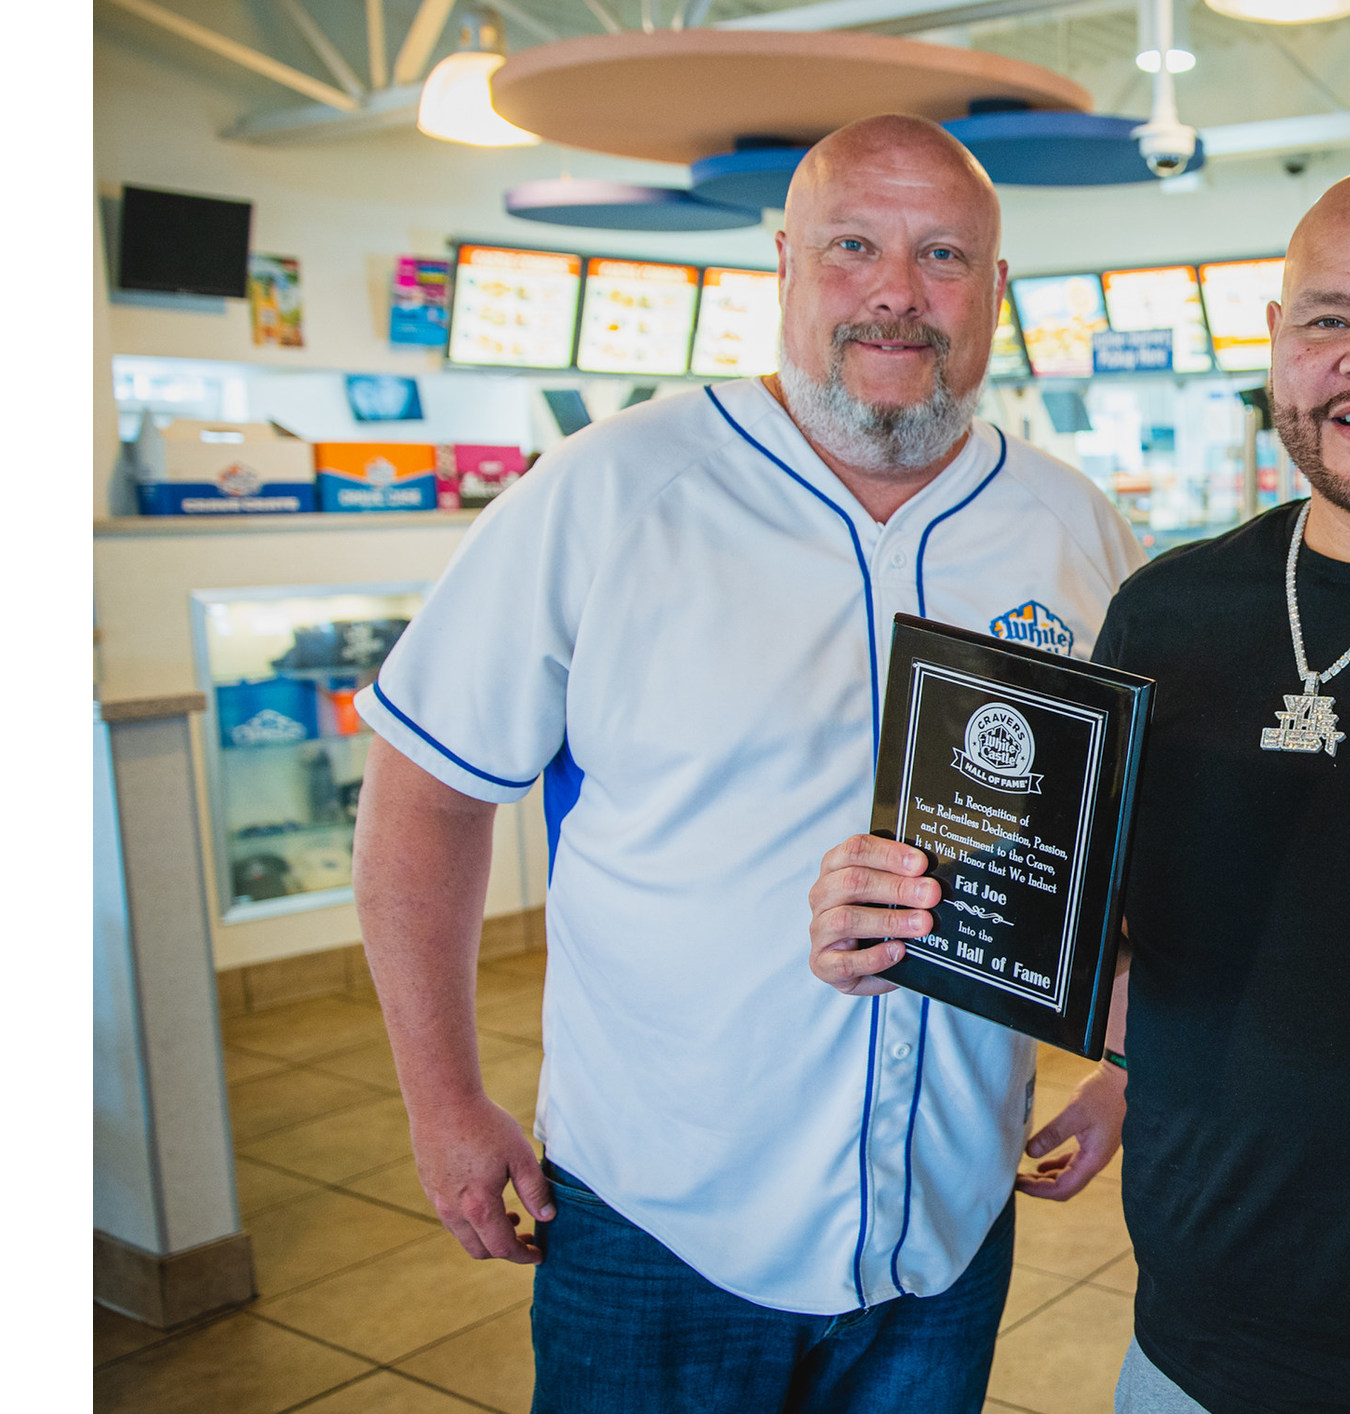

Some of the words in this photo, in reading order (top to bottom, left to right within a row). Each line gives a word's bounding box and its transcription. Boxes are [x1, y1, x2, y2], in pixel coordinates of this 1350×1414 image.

[1004, 619, 1068, 648] White
[978, 713, 1025, 740] CRAVERS
[981, 746, 1016, 765] Castle
[985, 733, 1016, 754] White
[965, 763, 987, 781] HALL
[988, 775, 1001, 785] OF
[954, 791, 963, 806] In
[965, 795, 1017, 823] Recognition
[1019, 814, 1030, 828] of
[915, 796, 935, 814] Your
[937, 803, 979, 829] Relentless
[981, 819, 1031, 848] Dedication,
[1033, 835, 1068, 861] Passion,
[920, 821, 937, 834] and
[939, 824, 994, 854] Commitment
[997, 846, 1006, 858] to
[1008, 849, 1024, 864] the
[1025, 853, 1056, 876] Crave,
[914, 834, 922, 848] It
[924, 840, 932, 851] is
[934, 840, 956, 860] With
[958, 849, 986, 870] Honor
[988, 861, 1006, 877] that
[1009, 865, 1026, 884] We
[1028, 873, 1058, 895] Induct
[954, 874, 979, 896] Fat
[981, 884, 1008, 906] Joe
[958, 920, 976, 937] Into
[978, 928, 994, 943] the
[956, 940, 984, 965] Hall
[991, 956, 1007, 973] of
[1012, 961, 1051, 990] Fame
